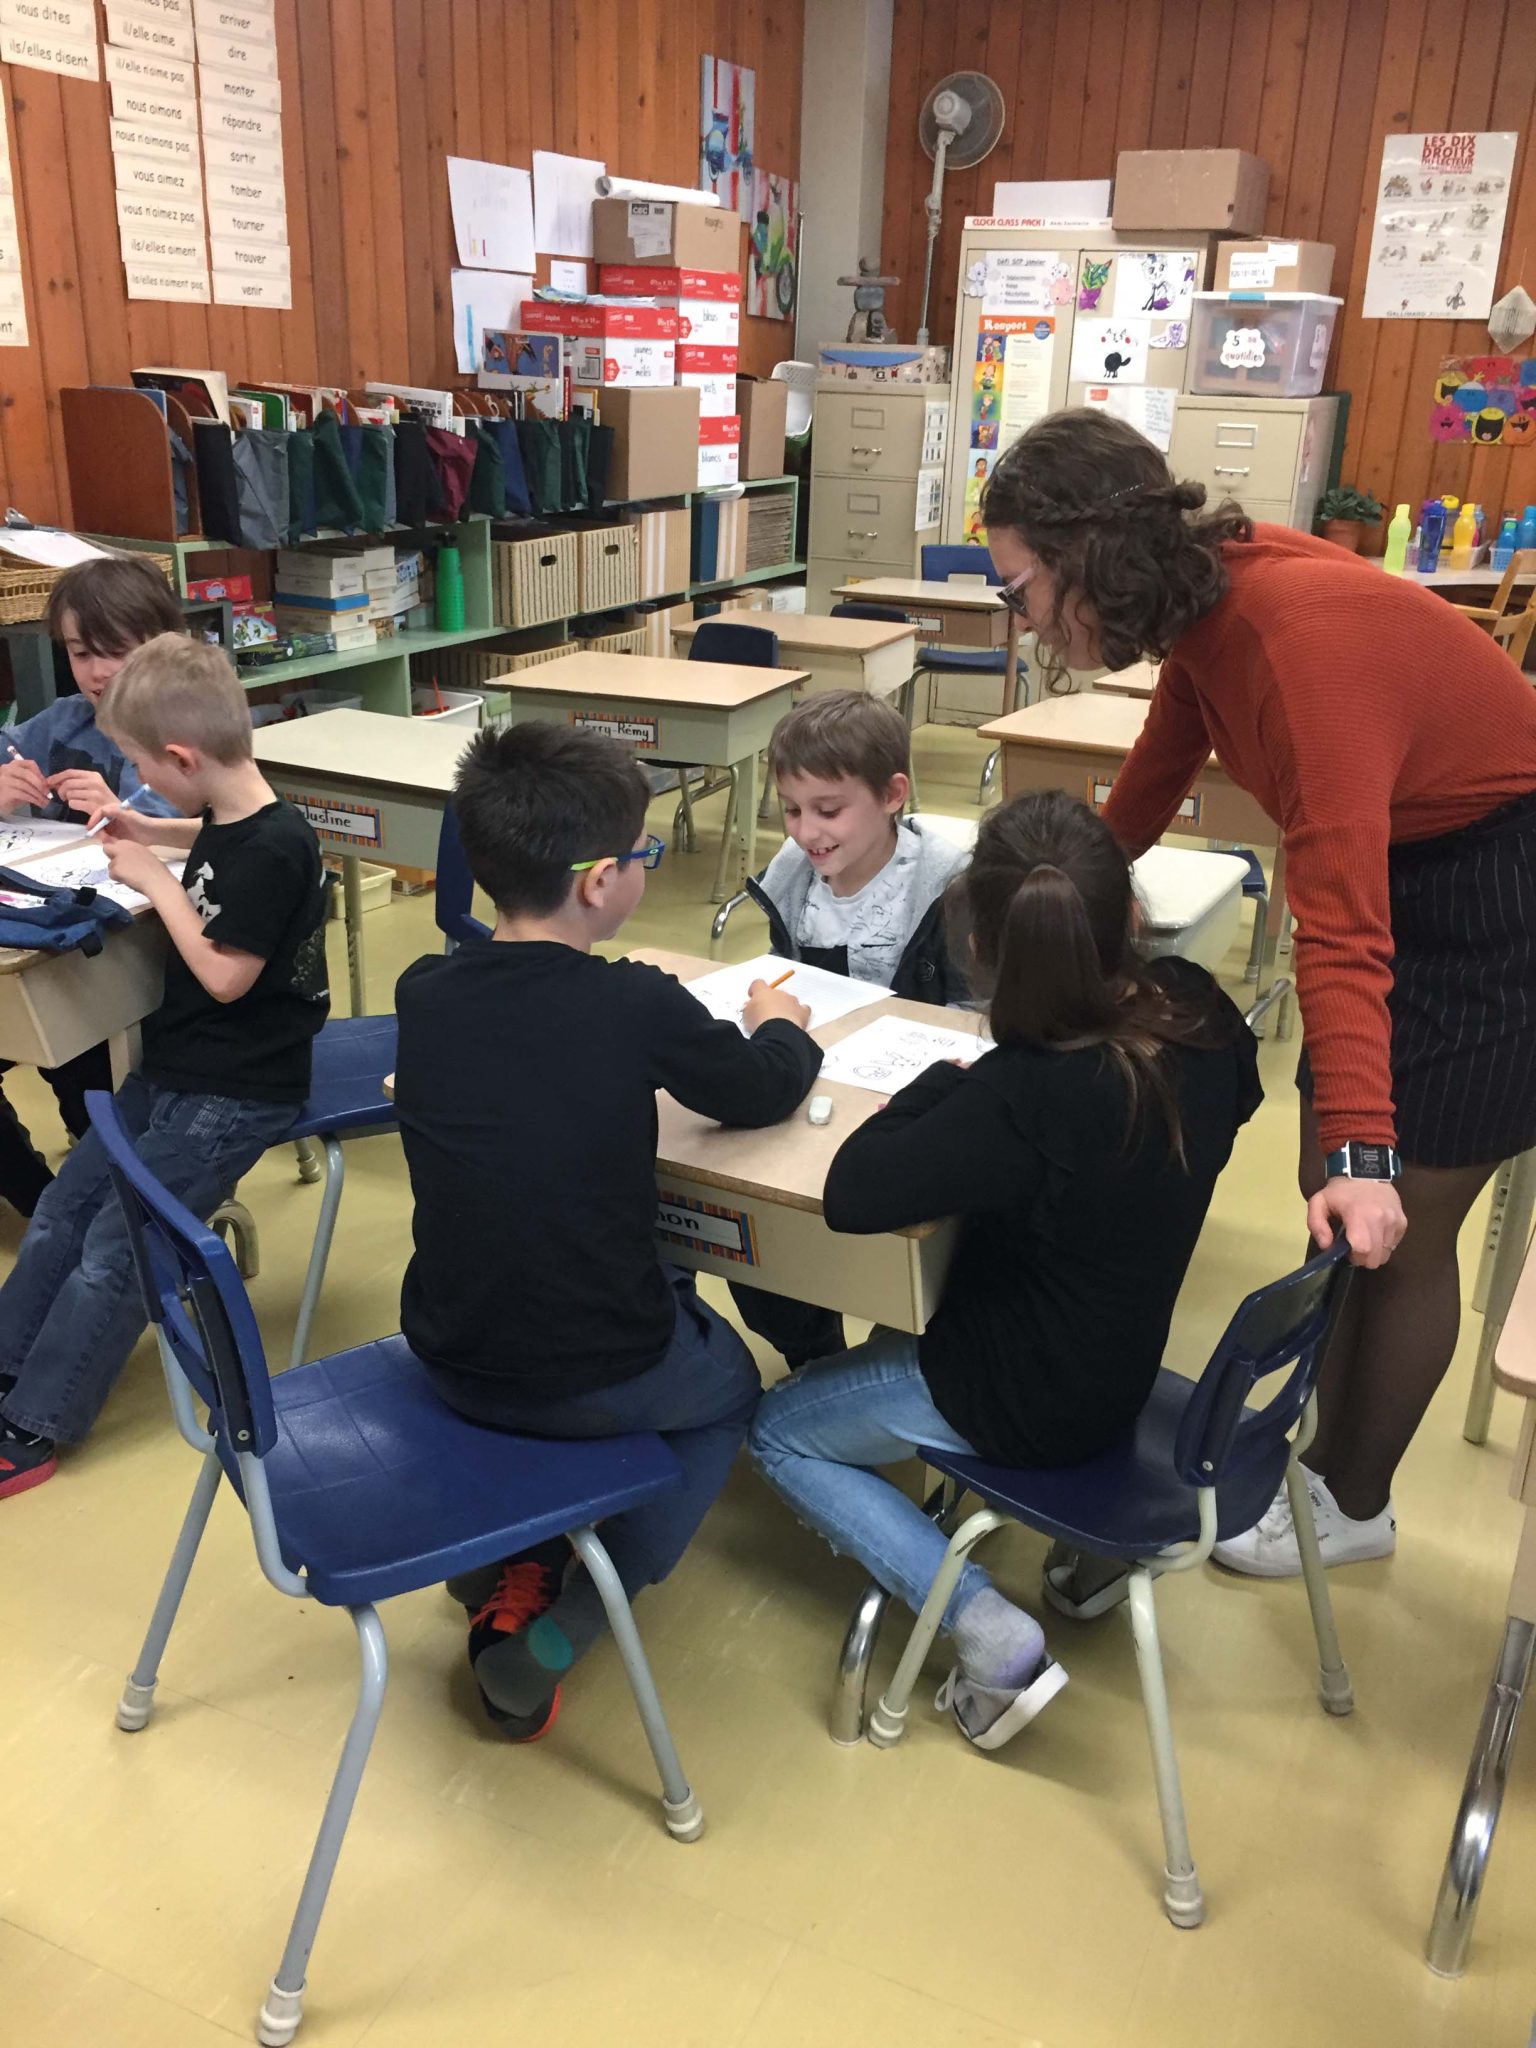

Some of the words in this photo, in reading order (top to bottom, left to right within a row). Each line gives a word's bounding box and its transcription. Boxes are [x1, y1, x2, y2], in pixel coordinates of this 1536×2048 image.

[16, 3, 39, 18] vous
[42, 6, 70, 25] dites
[219, 13, 251, 29] arriver
[152, 32, 176, 47] aime
[9, 38, 52, 61] ils/elles
[55, 48, 88, 67] disent
[227, 45, 247, 61] dire
[170, 72, 185, 82] pas
[223, 83, 255, 98] monter
[126, 99, 147, 113] nous
[149, 104, 182, 120] aimons
[221, 113, 262, 132] répondre
[115, 130, 136, 142] nous
[175, 142, 190, 153] pas
[1424, 135, 1446, 147] LES
[1451, 134, 1476, 149] DIX
[230, 151, 256, 165] sortir
[1422, 147, 1475, 159] DROITS
[133, 170, 155, 183] vous
[157, 174, 185, 188] aimez
[230, 184, 263, 198] tomber
[122, 204, 143, 216] vous
[180, 212, 195, 223] pas
[232, 217, 265, 232] tourner
[972, 218, 995, 227] CLOCK
[997, 218, 1020, 227] CLASS
[168, 245, 197, 257] aiment
[234, 250, 267, 265] trouver
[190, 281, 204, 291] pas
[241, 284, 264, 297] venir
[1232, 335, 1240, 347] 5
[302, 804, 351, 828] Justine
